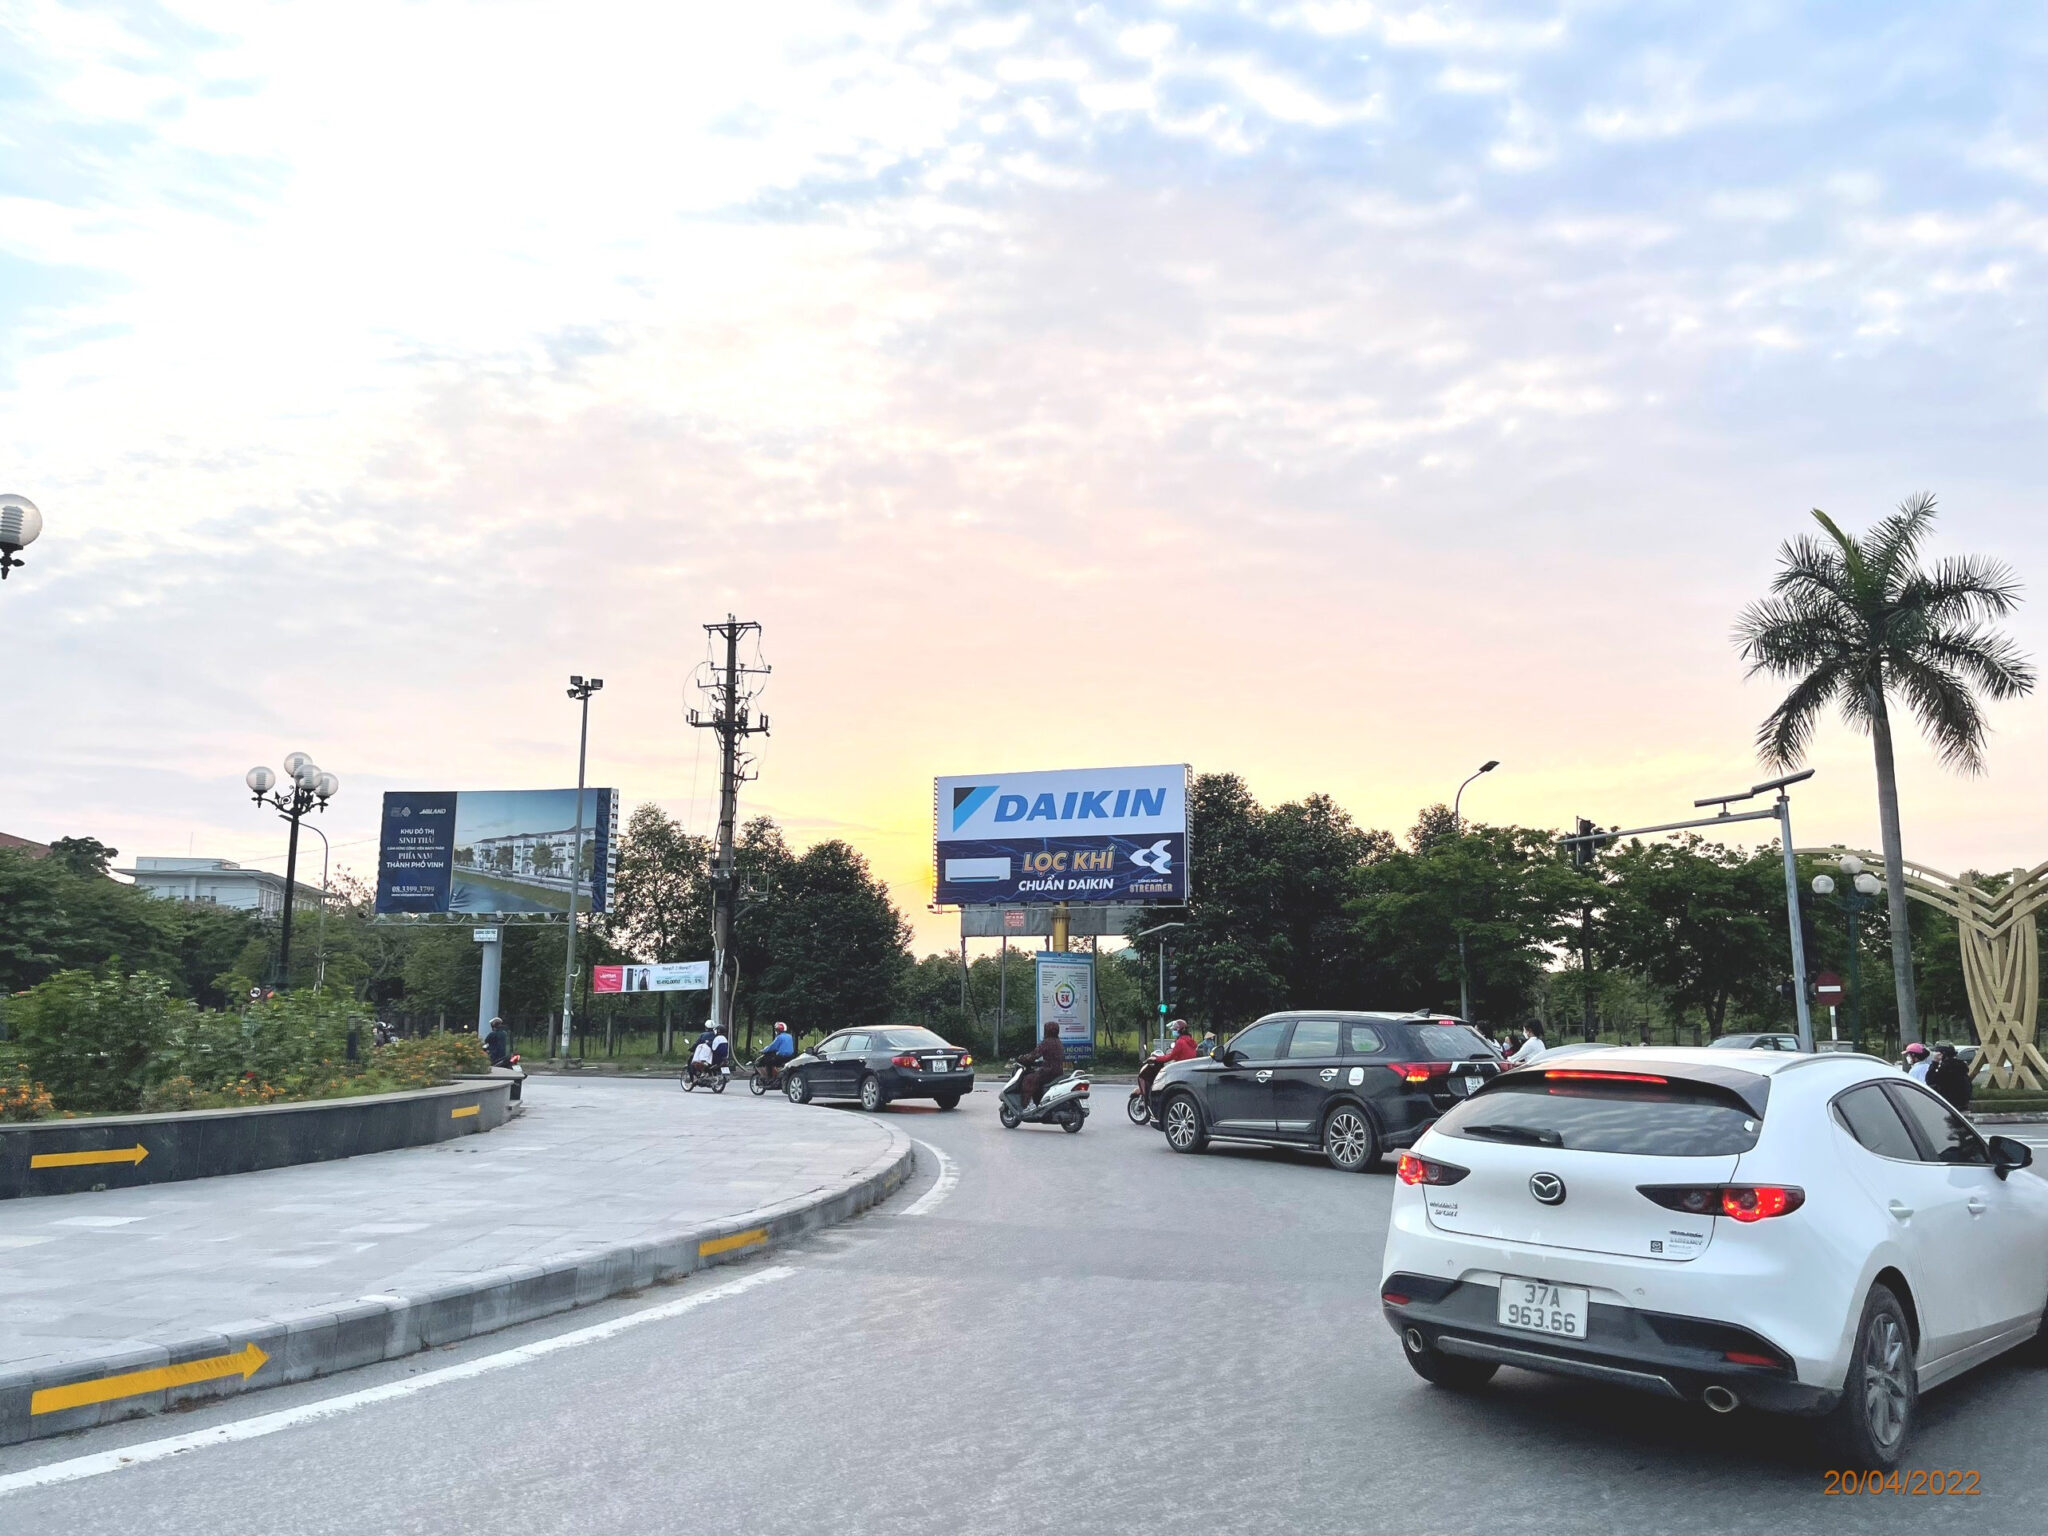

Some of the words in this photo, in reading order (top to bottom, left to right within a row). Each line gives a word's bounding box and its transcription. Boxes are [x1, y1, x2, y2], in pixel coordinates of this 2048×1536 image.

[994, 787, 1167, 823] DAIKIN
[414, 826, 424, 835] ĐÔ
[424, 828, 435, 836] THỊ
[386, 860, 410, 868] THÀNH
[411, 859, 426, 868] PHỐ
[1020, 850, 1068, 877] LỌC
[1072, 843, 1118, 872] KHÍ
[1017, 874, 1065, 892] CHUẨN
[1067, 878, 1115, 891] DAIKIN
[1129, 883, 1173, 893] STREAMER
[1524, 1284, 1560, 1308] 37A
[1508, 1304, 1576, 1333] 963.66
